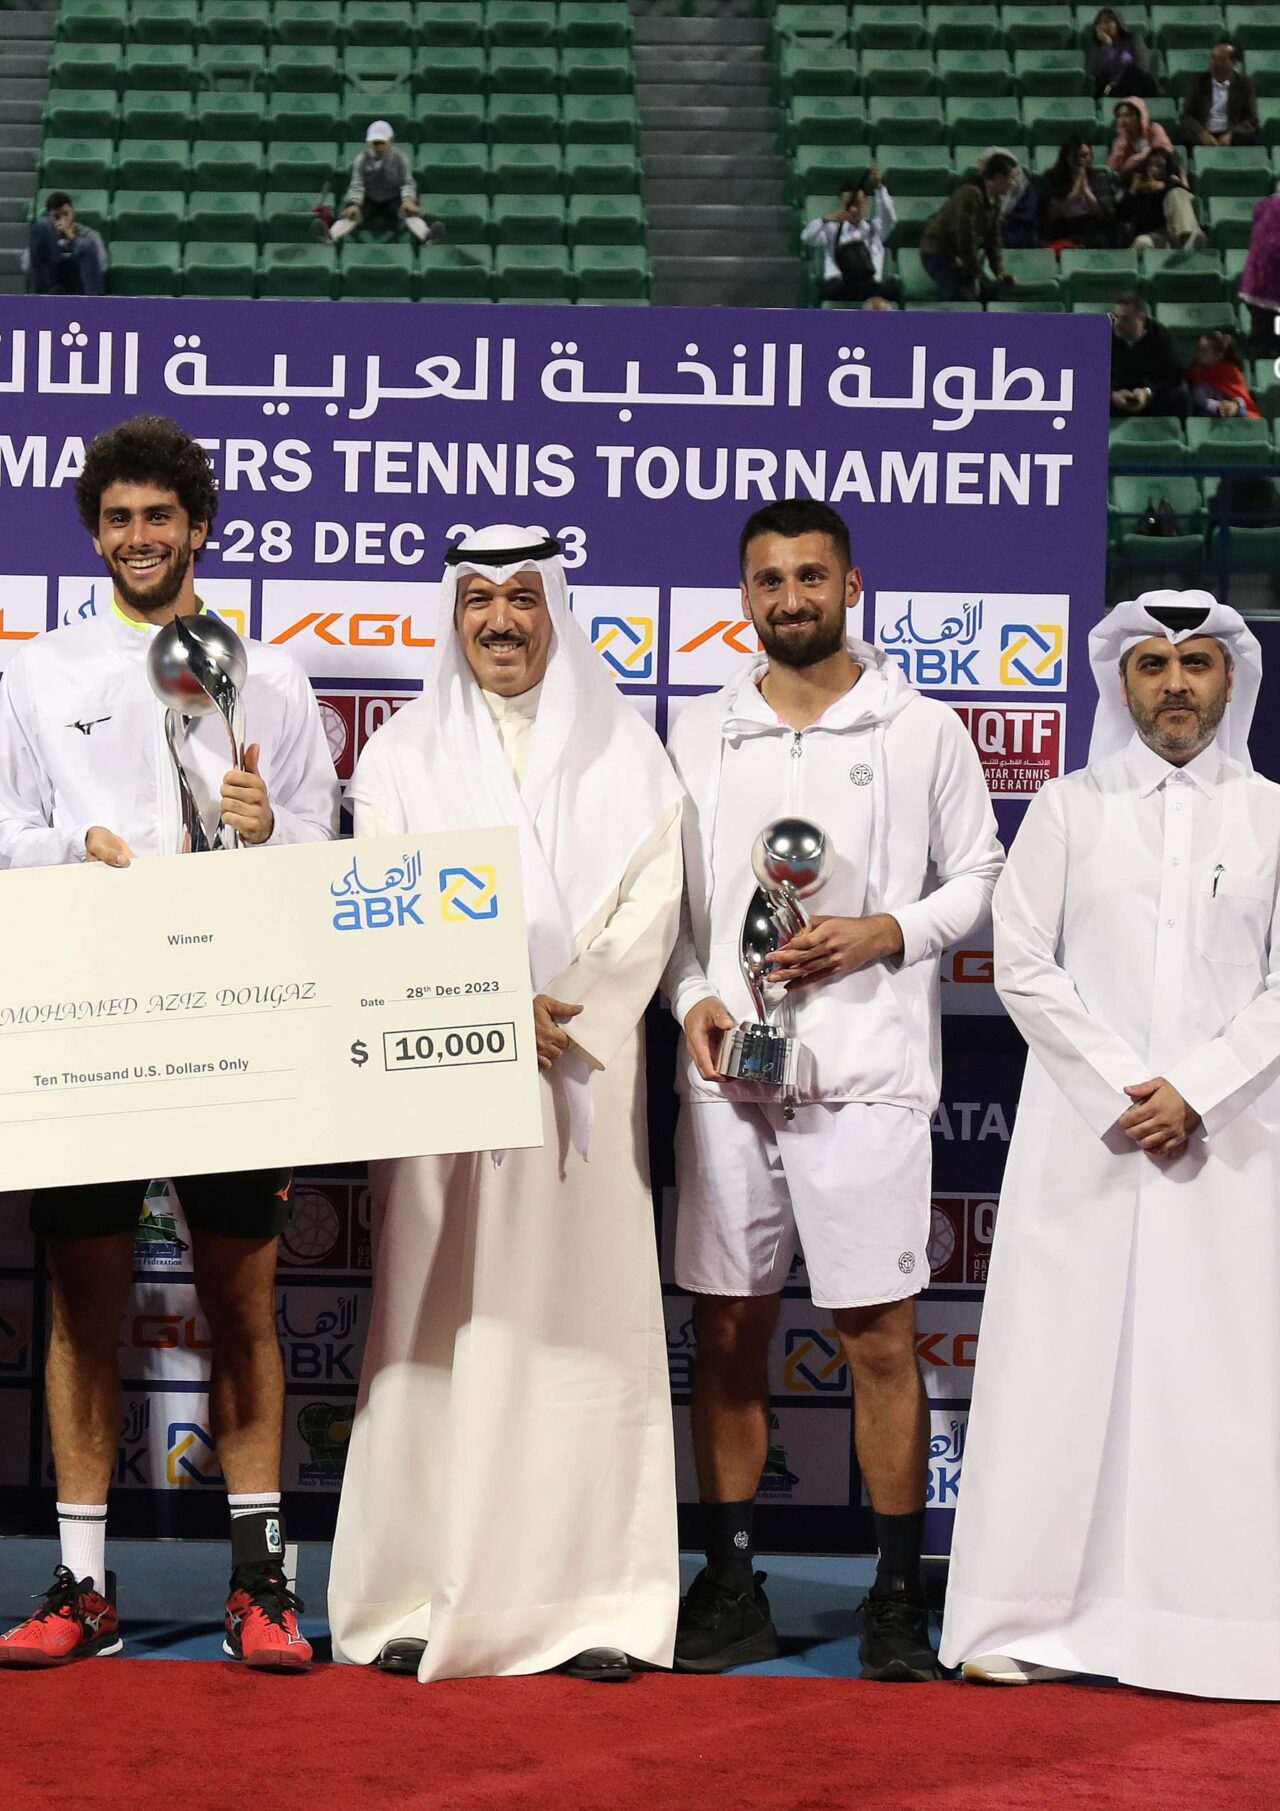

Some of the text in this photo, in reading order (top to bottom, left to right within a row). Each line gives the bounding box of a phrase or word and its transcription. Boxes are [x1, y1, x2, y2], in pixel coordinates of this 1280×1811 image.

[163, 334, 516, 420] العربية
[541, 342, 802, 422] النخبة
[828, 346, 1073, 431] بطولة
[332, 440, 576, 498] TENNIS
[596, 446, 1073, 506] TOURNAMENT
[314, 521, 425, 566] DEC
[268, 612, 436, 647] KGL
[880, 599, 984, 646] الأهلي
[978, 711, 1055, 755] QTF
[984, 768, 1050, 780] ATAR TENNIS
[330, 850, 422, 896] الأهلي
[167, 934, 214, 946] Winner
[0, 982, 317, 1027] MOHAMED AZIZ DOUGAZ
[360, 998, 385, 1008] Date
[406, 981, 500, 998] 28th Dec 2023
[350, 1030, 506, 1068] $ 10,000
[33, 1058, 249, 1087] Ten Thousand U.S. Dollars Only
